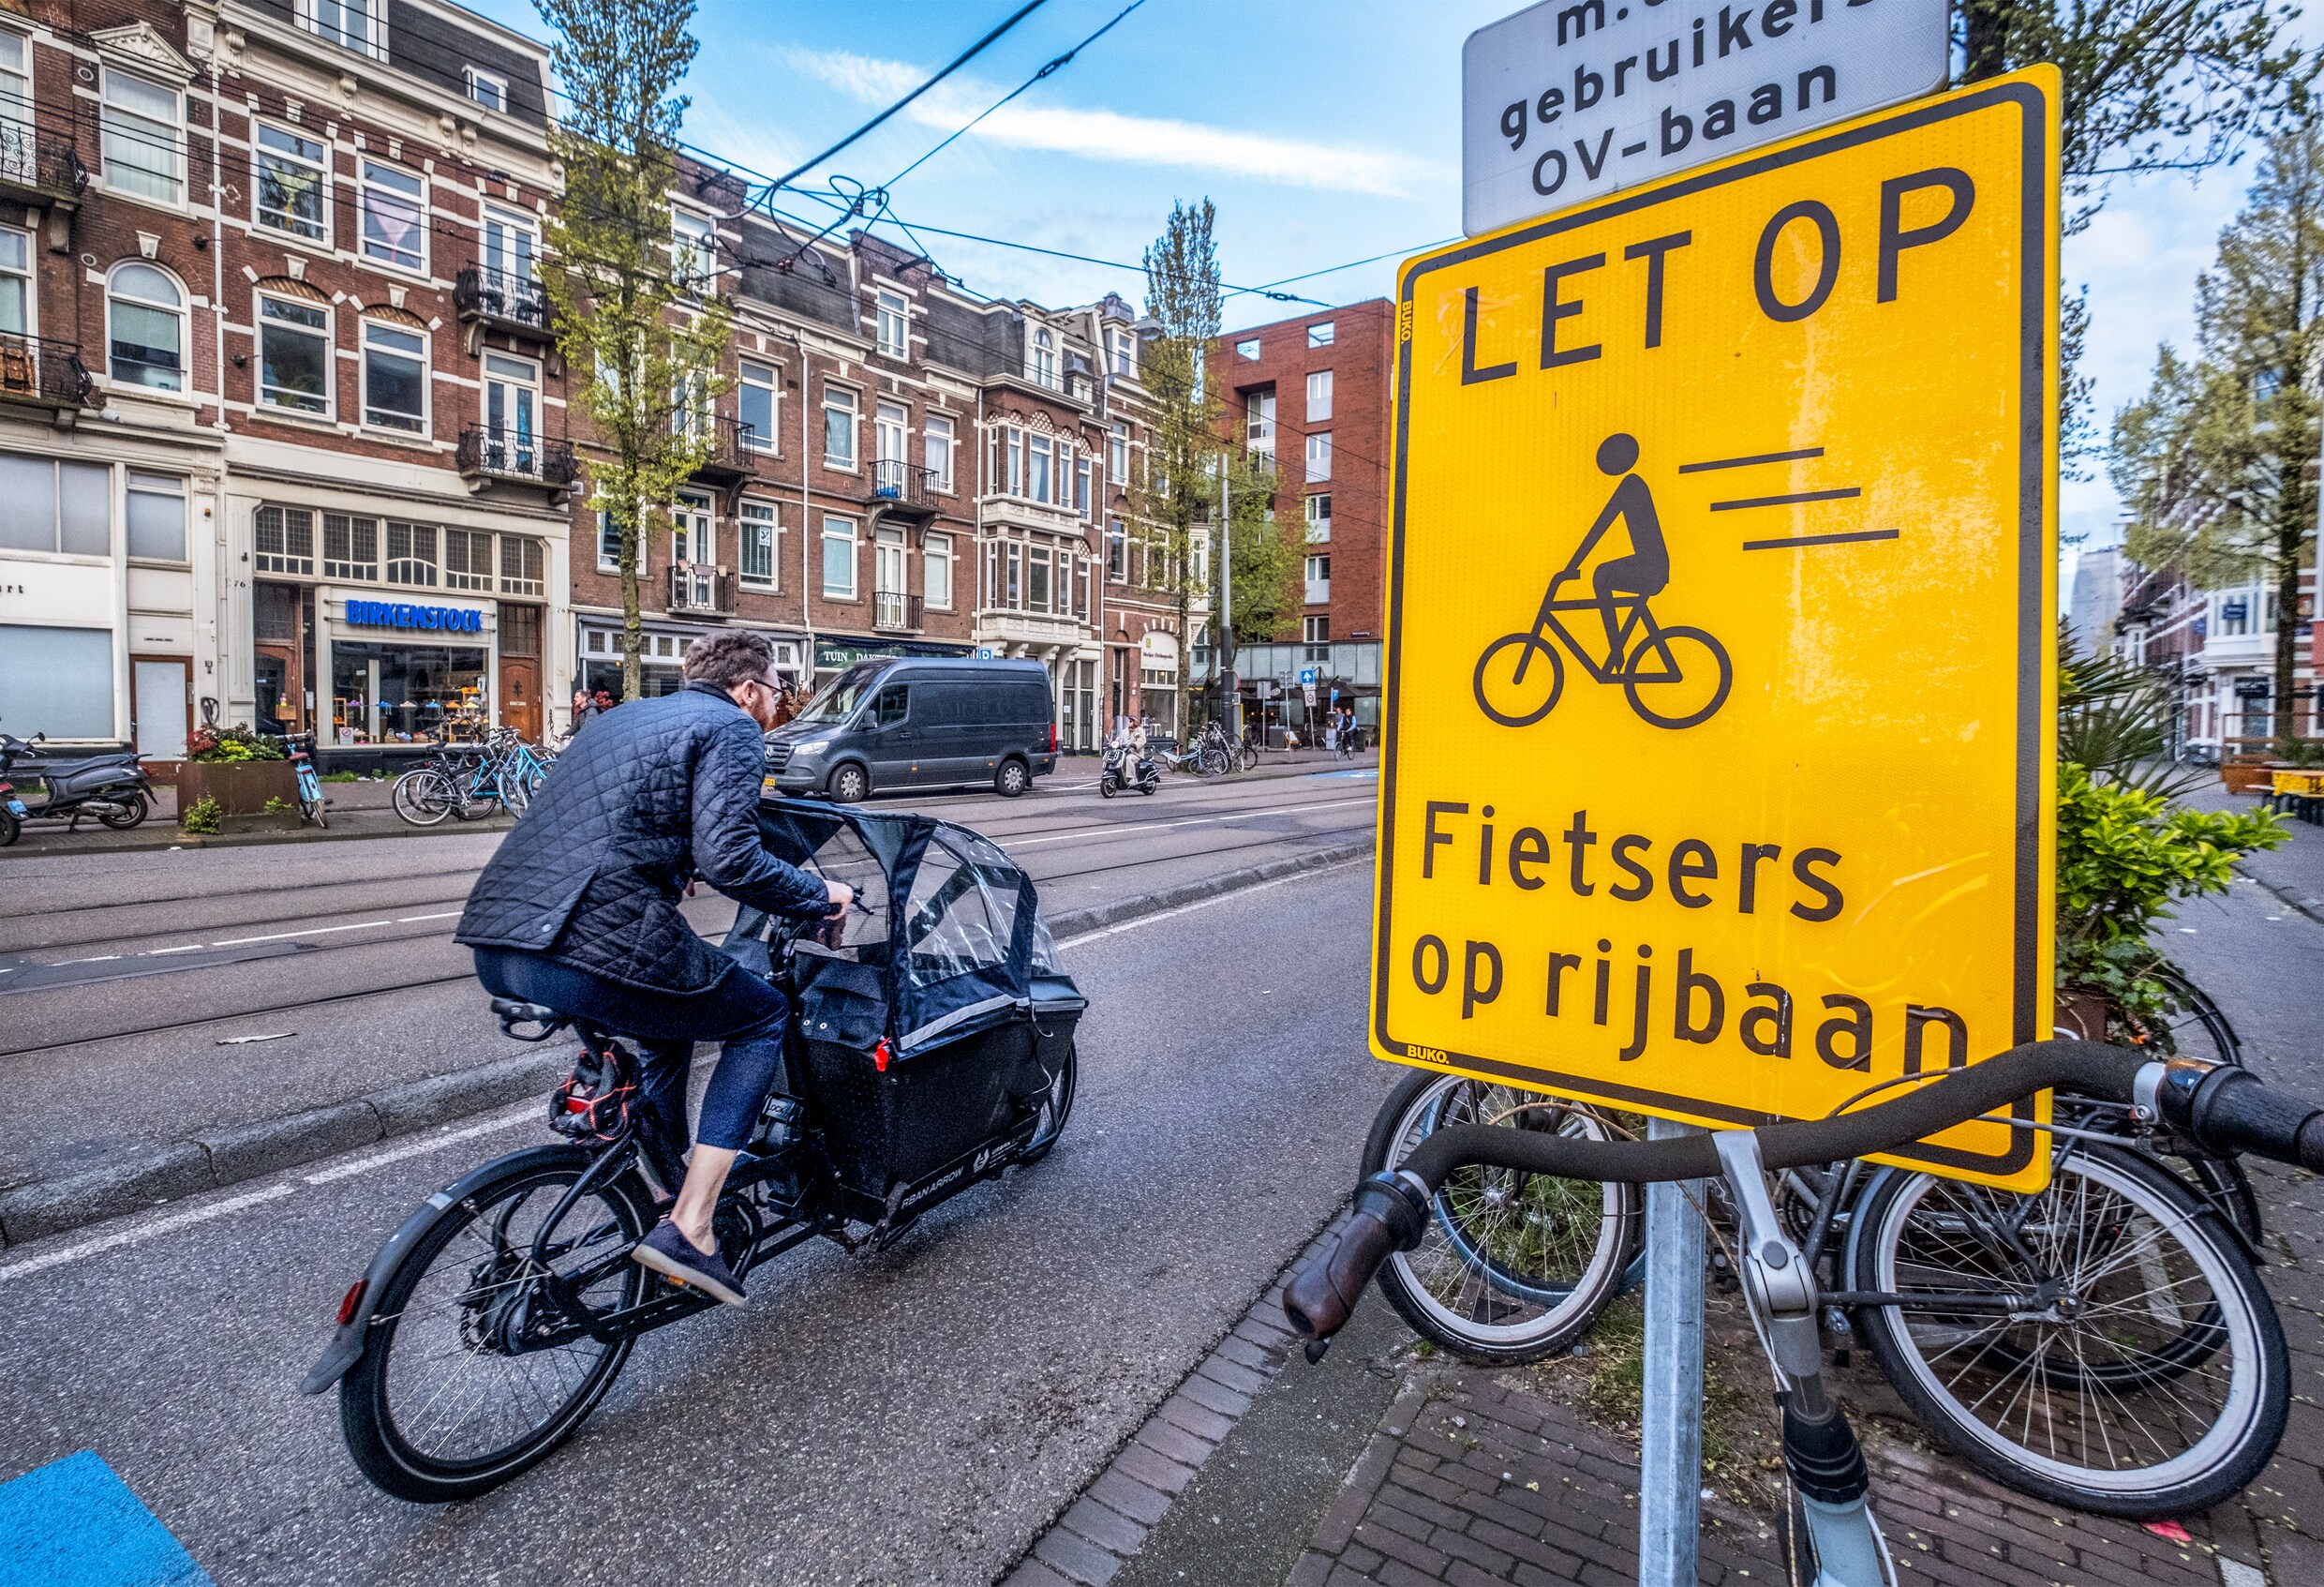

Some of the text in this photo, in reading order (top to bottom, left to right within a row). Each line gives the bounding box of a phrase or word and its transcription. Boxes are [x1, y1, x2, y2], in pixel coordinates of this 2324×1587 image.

[1557, 0, 1667, 47] m.
[1500, 0, 1873, 151] gebruike
[1532, 64, 1837, 196] OV-baan
[1461, 167, 1975, 386] LET OP
[345, 599, 483, 632] BIRKENSTOCK
[824, 651, 848, 662] TUIN
[1422, 800, 1844, 922] Fietsers
[1411, 934, 1968, 1082] op rijbaan
[1408, 1044, 1450, 1065] BUKO.
[901, 1166, 964, 1209] RBAN ARROW
